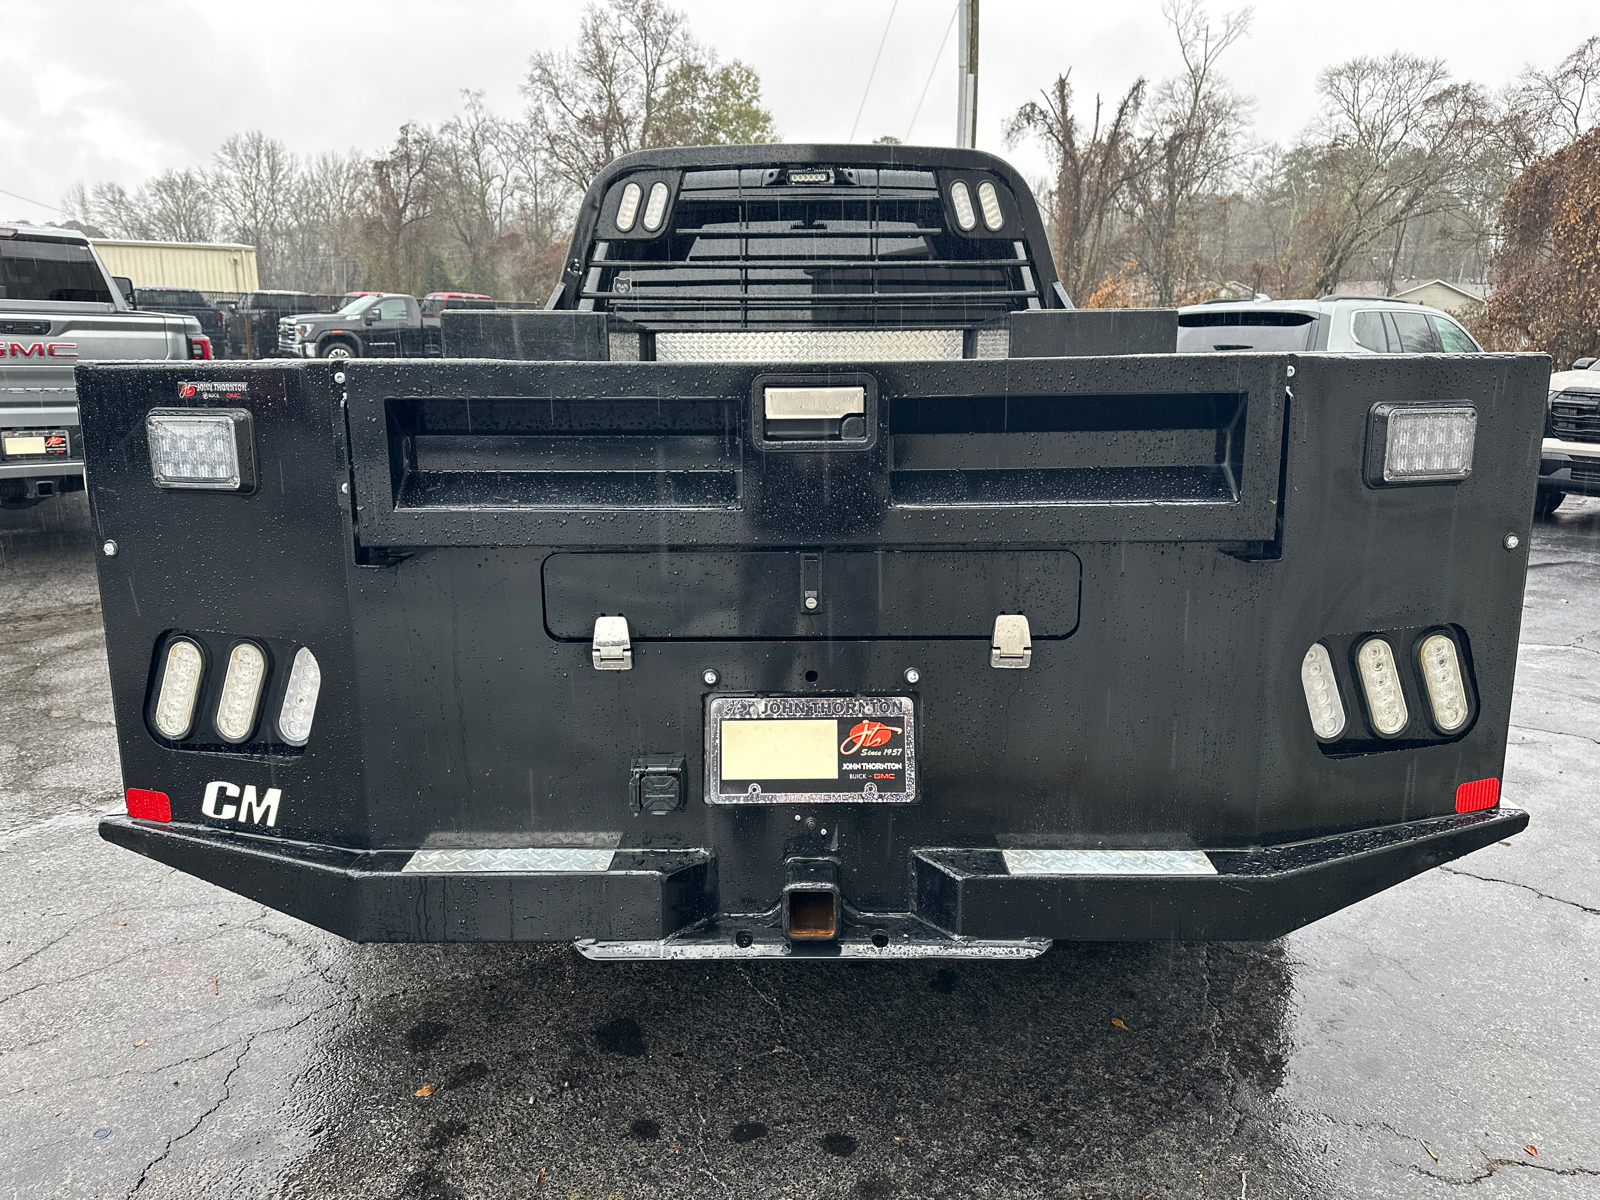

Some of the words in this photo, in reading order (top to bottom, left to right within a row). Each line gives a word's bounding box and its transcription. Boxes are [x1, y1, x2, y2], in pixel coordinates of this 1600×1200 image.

[0, 342, 78, 358] MC
[214, 383, 248, 392] THORNTON
[761, 702, 807, 715] JOHN
[810, 700, 904, 715] THORNTON
[860, 748, 882, 756] Since
[883, 748, 903, 756] 1957
[842, 762, 861, 770] JOHN
[861, 762, 903, 770] THORNTON
[201, 781, 282, 828] CM
